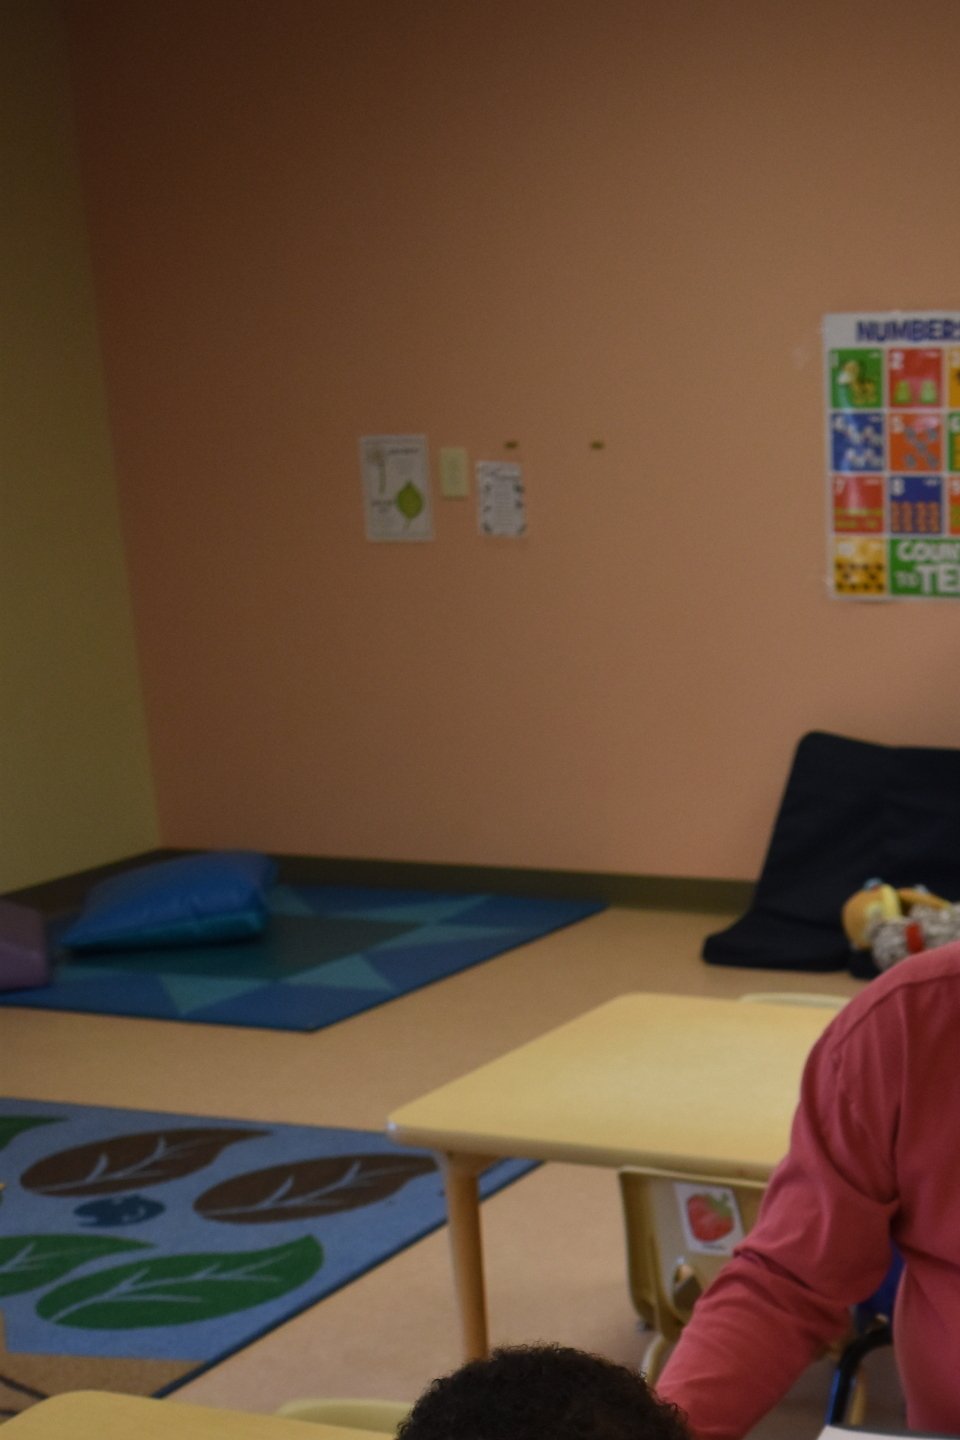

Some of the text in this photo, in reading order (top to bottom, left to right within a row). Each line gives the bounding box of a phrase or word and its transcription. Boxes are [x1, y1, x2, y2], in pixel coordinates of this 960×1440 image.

[891, 351, 904, 370] 2
[836, 478, 847, 496] 7
[891, 478, 905, 497] 8
